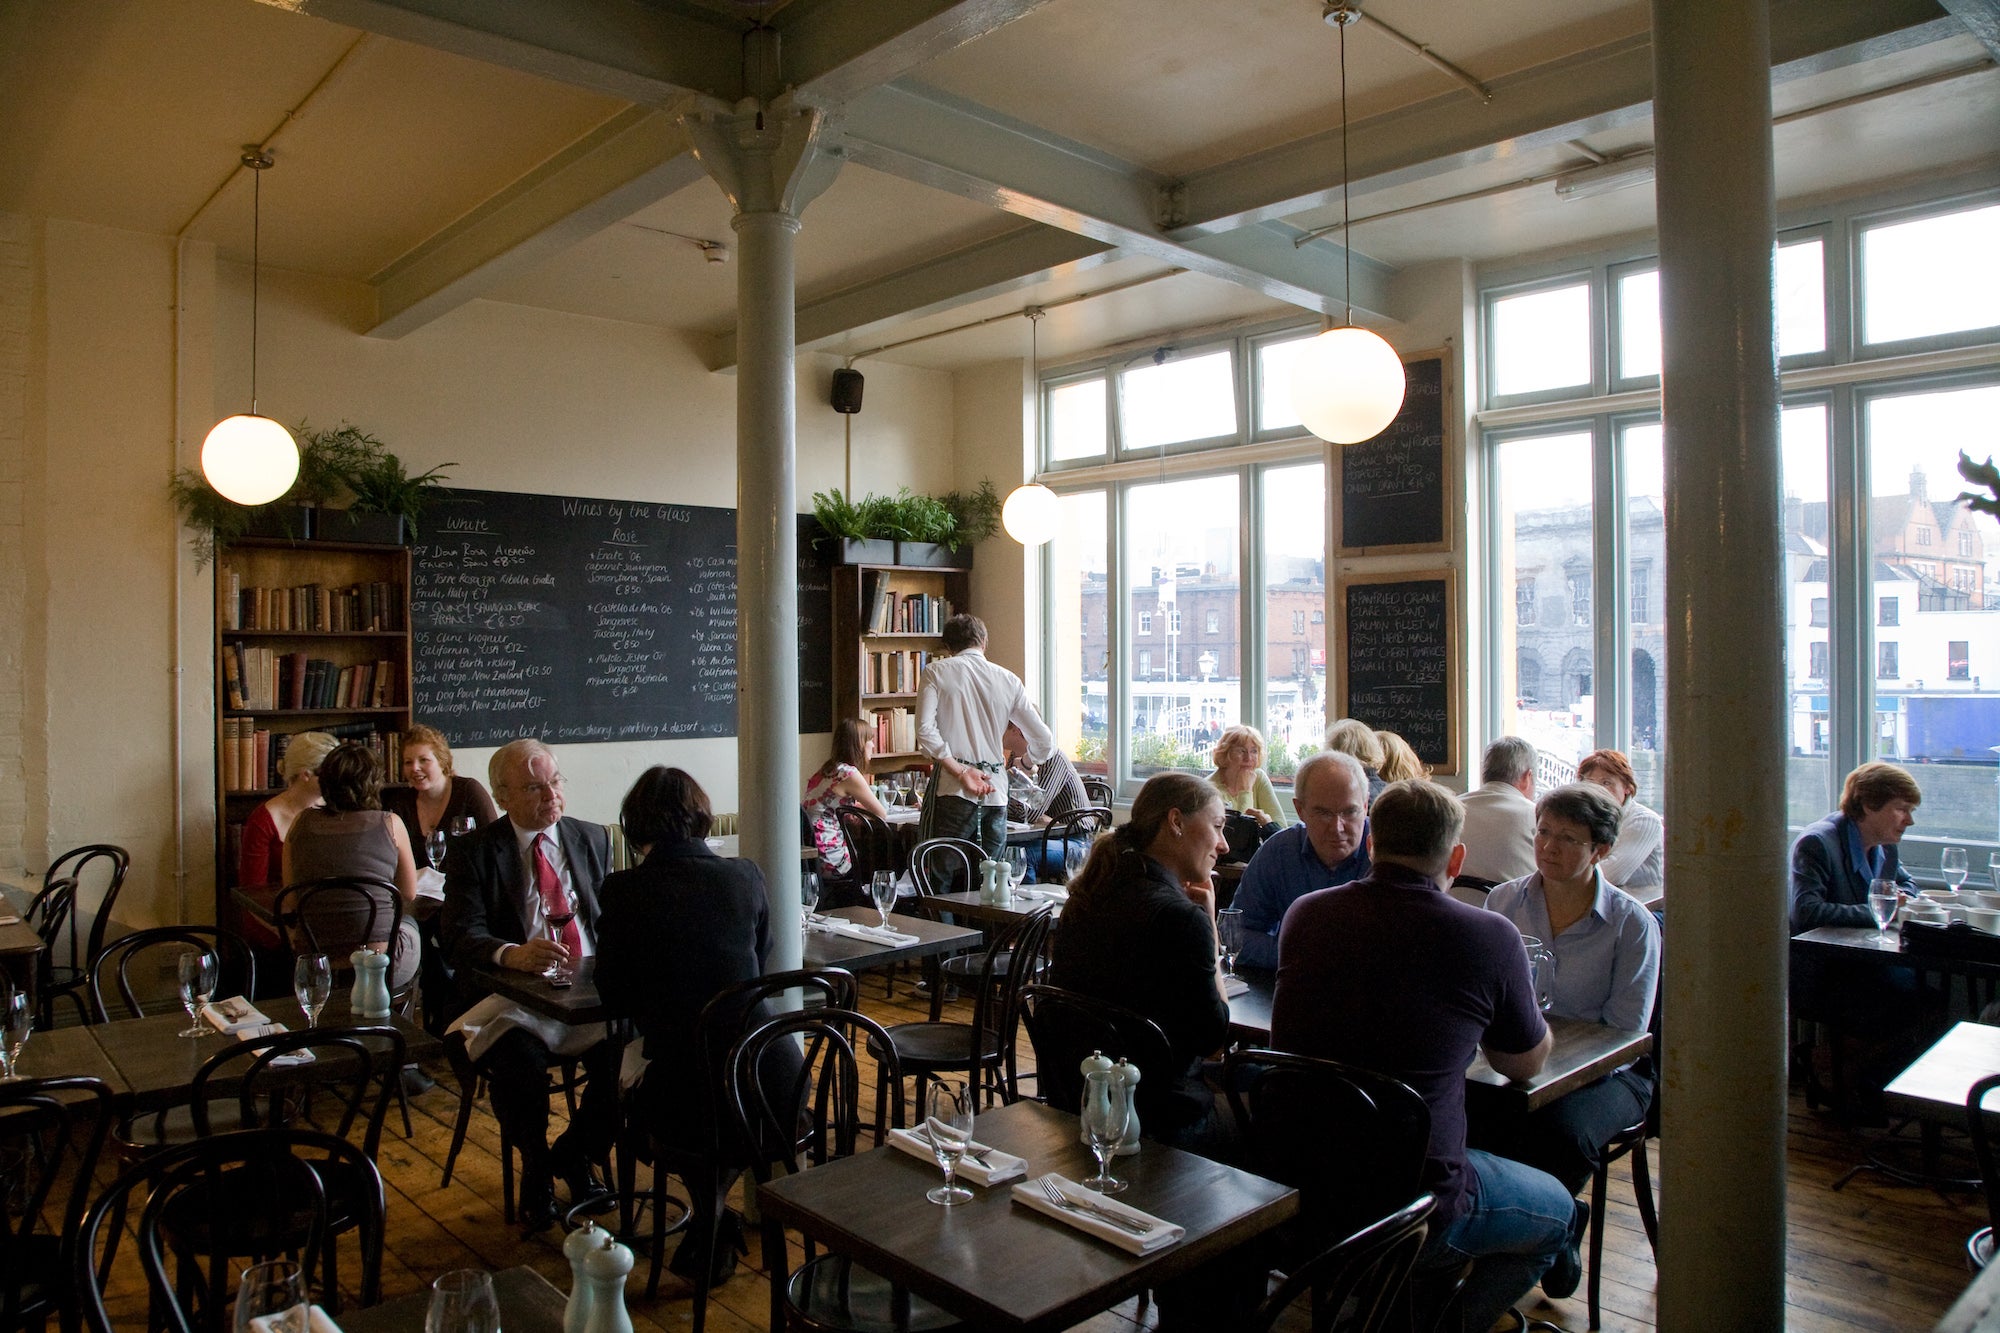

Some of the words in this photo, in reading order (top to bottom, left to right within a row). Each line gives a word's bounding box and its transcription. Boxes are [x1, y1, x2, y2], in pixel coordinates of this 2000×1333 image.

[562, 498, 602, 518] Wines
[609, 504, 625, 525] by
[629, 505, 650, 519] the
[656, 505, 691, 523] Glass
[447, 515, 489, 531] White
[612, 527, 639, 543] Rosé
[1351, 618, 1390, 632] SALMON
[433, 658, 457, 670] Wild
[492, 667, 525, 682] Zealand
[492, 698, 527, 712] Zealand
[541, 720, 552, 741] for
[670, 719, 699, 734] dessert
